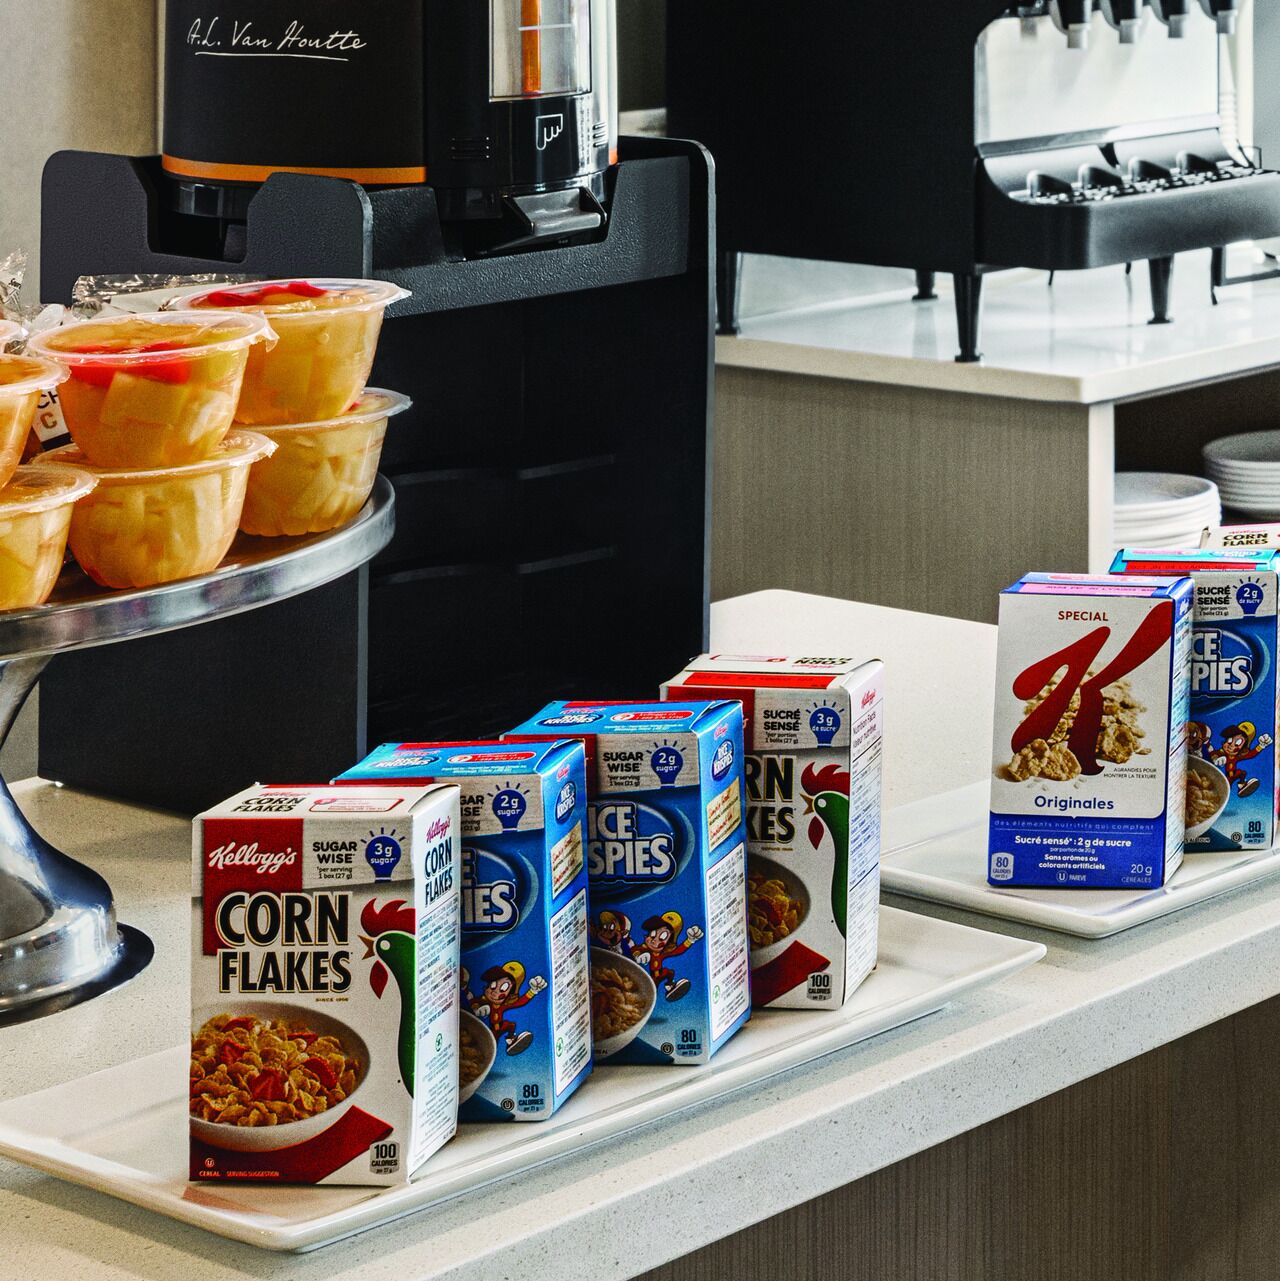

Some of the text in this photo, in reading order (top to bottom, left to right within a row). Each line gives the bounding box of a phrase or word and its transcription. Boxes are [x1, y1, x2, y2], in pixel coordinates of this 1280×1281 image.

[231, 20, 272, 48] Van
[276, 20, 367, 51] Houtte
[1197, 584, 1231, 595] SUCRÉ
[1243, 589, 1258, 599] 2 g
[1197, 595, 1231, 605] SENSÉ
[1058, 610, 1109, 622] SPECIAL
[1192, 658, 1249, 691] PIES
[1011, 601, 1173, 776] K
[763, 708, 801, 720] SUCRÉ
[817, 713, 833, 726] 3 g
[763, 720, 801, 731] SENSÉ
[603, 752, 643, 762] SUGAR
[659, 753, 676, 766] 2 g
[607, 763, 641, 772] WISE
[656, 764, 679, 773] sugar
[745, 756, 796, 802] RN
[241, 797, 307, 805] CORN
[461, 795, 484, 804] GAR
[500, 796, 519, 809] 2 g
[1034, 795, 1114, 811] Originales
[231, 804, 300, 812] FLAKES
[461, 806, 481, 816] ISE
[497, 808, 522, 817] sugar
[589, 804, 634, 839] ICE
[746, 807, 795, 843] KES
[1248, 821, 1261, 832] 80
[312, 841, 357, 852] SUGAR
[1015, 835, 1042, 845] Sucré
[1042, 837, 1073, 846] sensé
[1078, 838, 1084, 846] 2
[1084, 840, 1091, 848] g
[1092, 839, 1105, 847] de
[374, 843, 393, 857] 3 g
[589, 835, 673, 876] SPIES
[208, 841, 297, 873] Kellogg's
[317, 853, 354, 864] WISE
[370, 857, 395, 866] sugar
[424, 836, 452, 878] CORN
[996, 856, 1009, 868] 80
[1044, 853, 1062, 861] Sans
[1062, 854, 1088, 862] arômes
[331, 866, 353, 874] serving
[1038, 861, 1105, 870] colorants artificiels
[1131, 864, 1152, 875] 20 g
[424, 867, 453, 908] FLAKES
[216, 892, 352, 946] CORN
[218, 949, 351, 993] FLAKES
[810, 975, 830, 988] 100
[681, 1029, 696, 1043] 80
[523, 1084, 539, 1097] 80
[374, 1143, 396, 1159] 100
[371, 1159, 398, 1167] CALORIES
